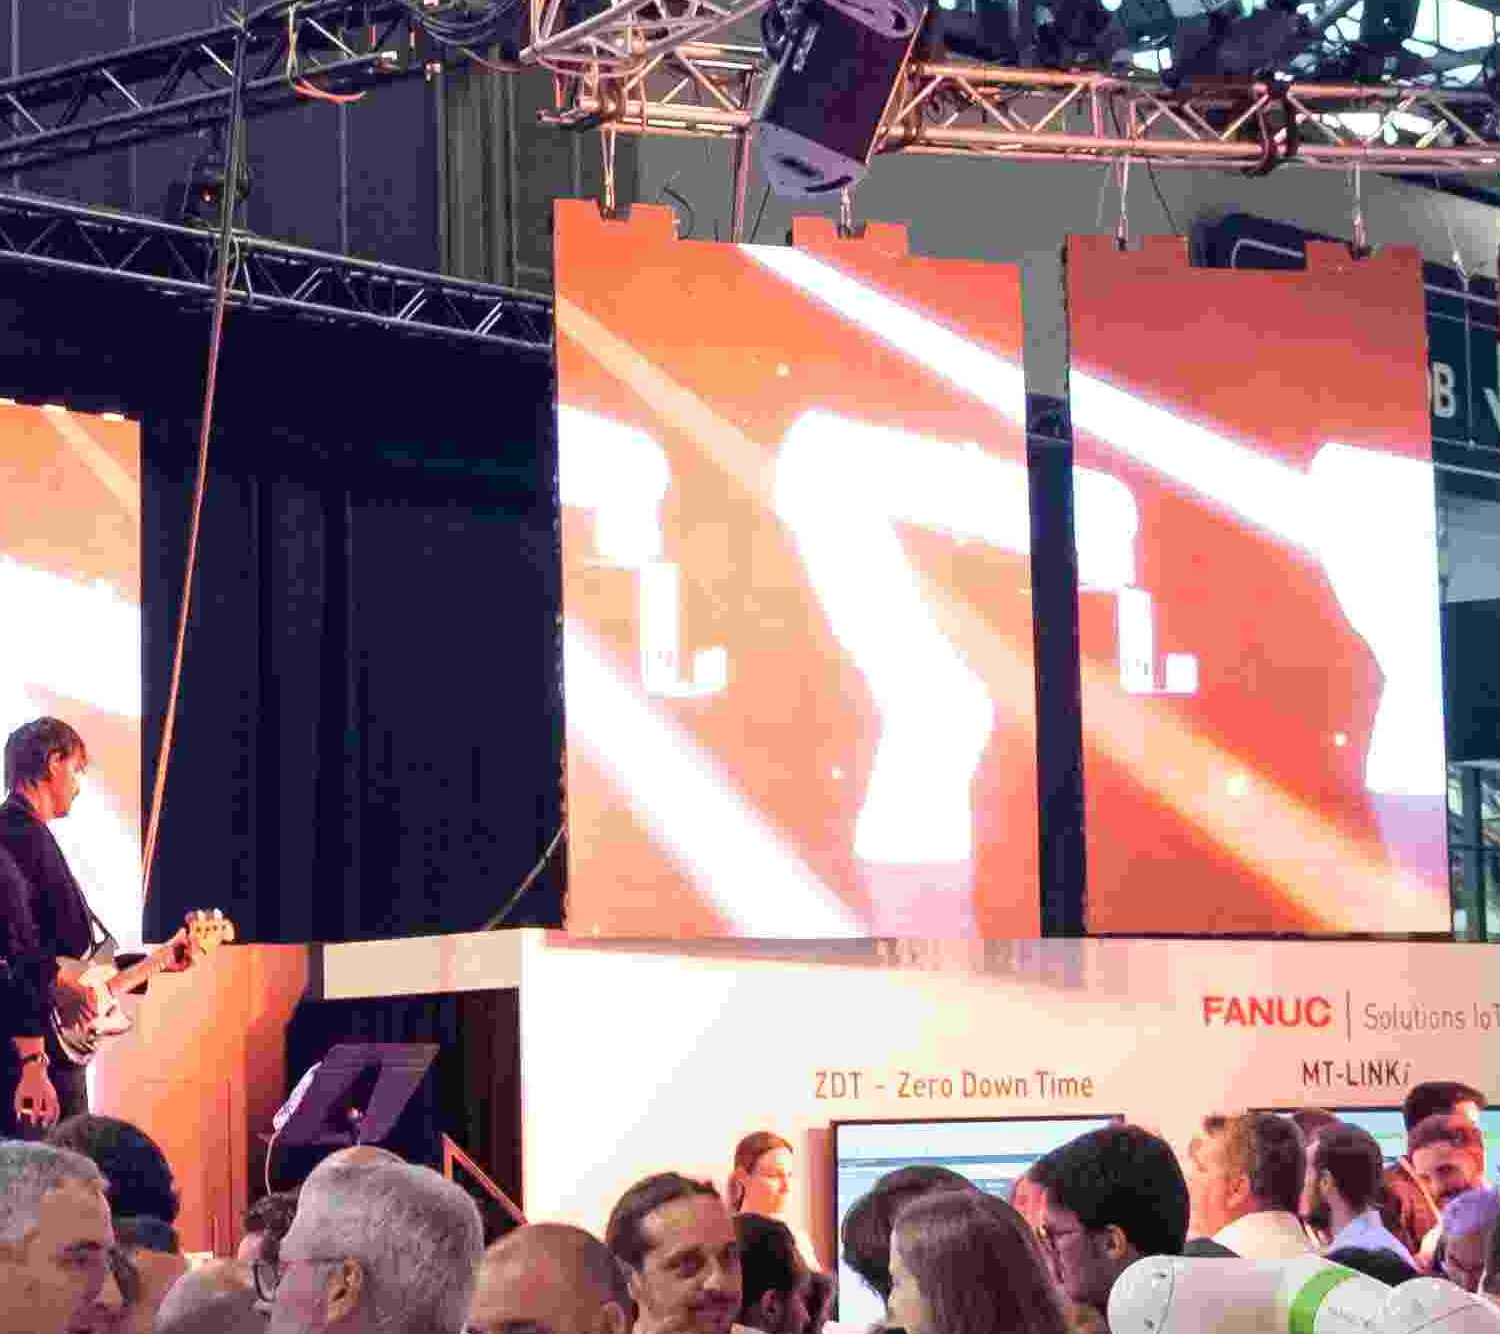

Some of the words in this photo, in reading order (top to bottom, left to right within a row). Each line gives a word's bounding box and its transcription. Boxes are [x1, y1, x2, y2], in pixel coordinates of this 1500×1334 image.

[1201, 995, 1332, 1027] FANUC
[1362, 1002, 1465, 1030] Solutions
[814, 1070, 863, 1099] ZDT
[897, 1070, 953, 1099] Zero
[961, 1068, 1029, 1099] Down
[1034, 1069, 1095, 1099] Time
